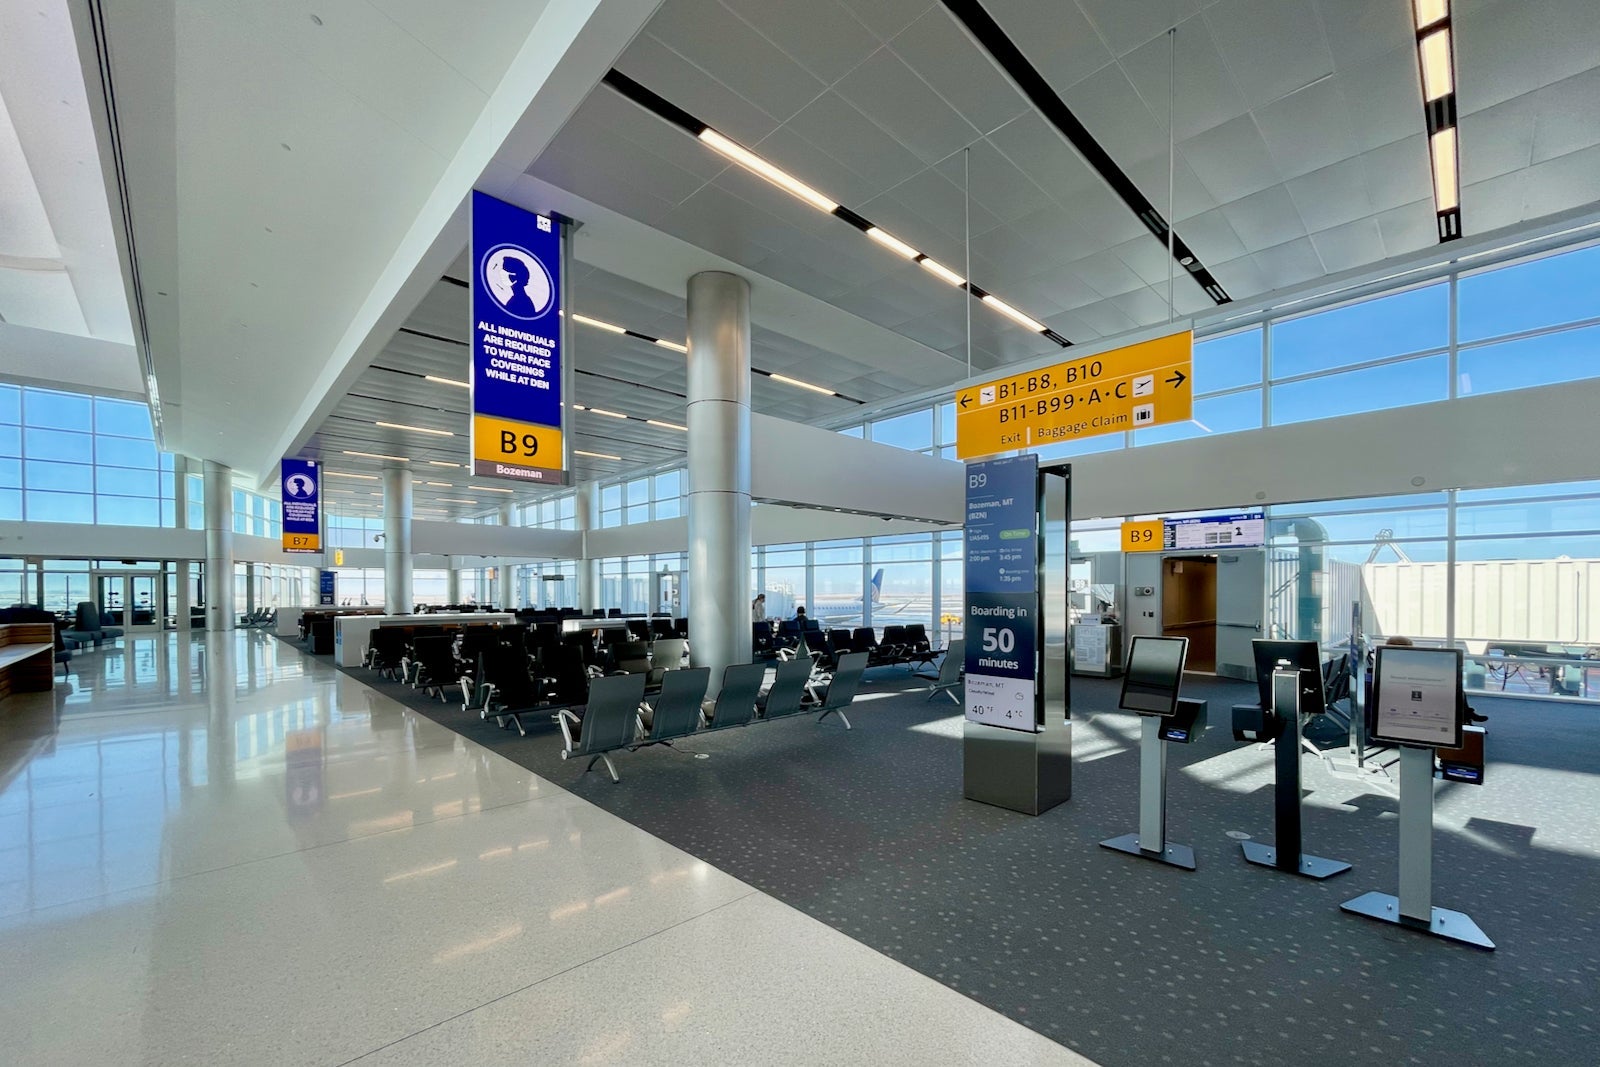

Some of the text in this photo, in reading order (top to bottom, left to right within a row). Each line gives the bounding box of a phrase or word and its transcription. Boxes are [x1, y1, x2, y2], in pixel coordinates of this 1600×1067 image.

[478, 321, 555, 348] ALL INDIVIDUALS
[483, 334, 551, 357] ARE REQUIRED
[483, 345, 551, 368] TO WEAR FACE
[490, 358, 544, 377] COVERINGS
[485, 368, 549, 389] WHILE AT DEN
[1000, 361, 1102, 398] B1-B8, B10
[1001, 412, 1128, 444] Exit Baggage Claim
[500, 430, 538, 456] B9
[496, 464, 542, 479] Bozeman
[969, 473, 987, 488] B9
[968, 497, 1014, 509] Bozeman, MT
[968, 511, 987, 520] (BZN)
[293, 537, 309, 546] B7
[1131, 529, 1153, 543] B9
[971, 605, 1027, 619] Boarding in
[982, 627, 1015, 653] 50
[978, 657, 1019, 669] minutes
[972, 705, 984, 715] 40
[1005, 710, 1012, 719] 4
